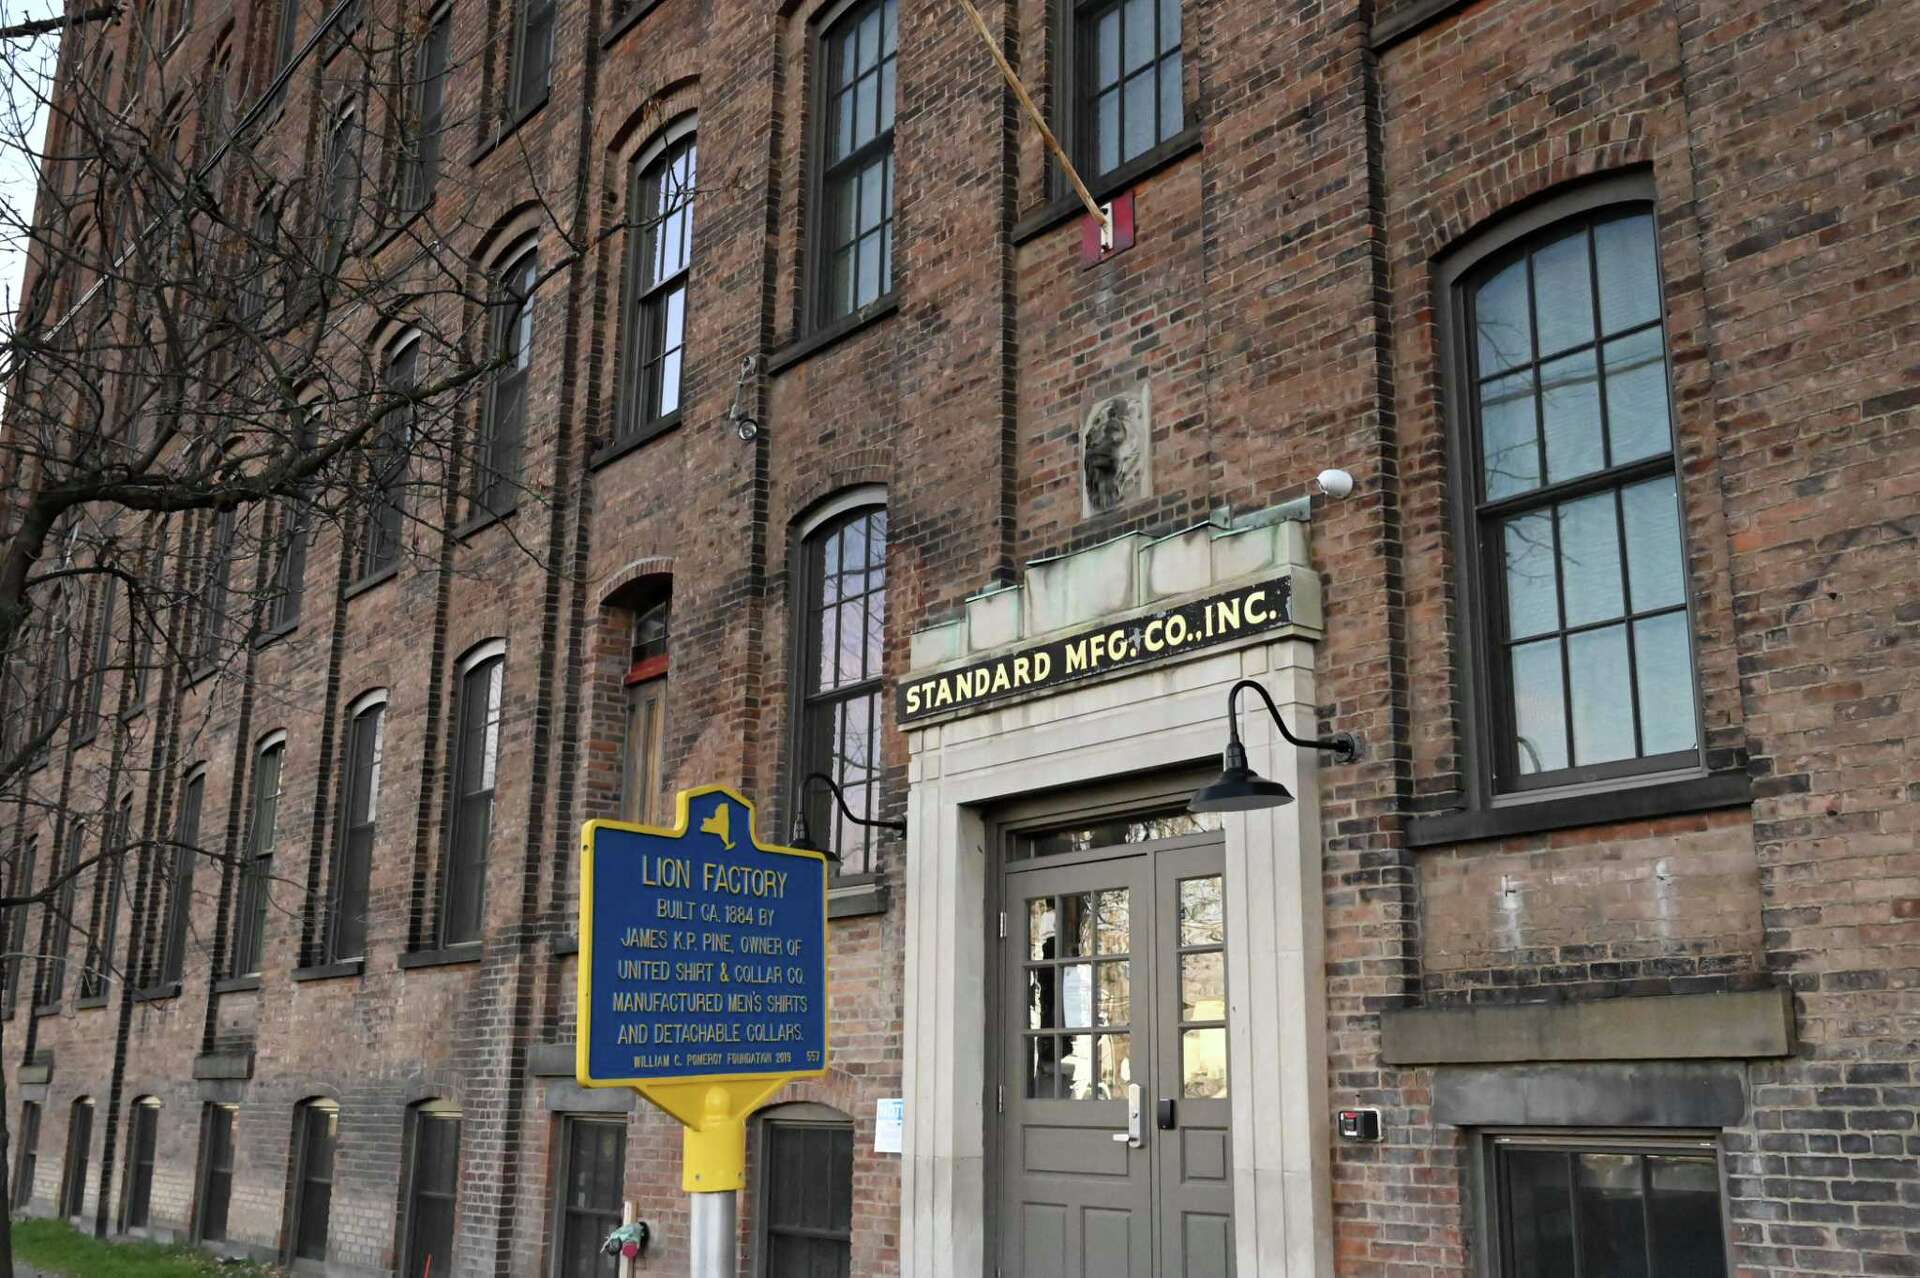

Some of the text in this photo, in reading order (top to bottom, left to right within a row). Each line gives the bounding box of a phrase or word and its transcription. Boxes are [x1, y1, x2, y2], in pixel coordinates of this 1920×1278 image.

[905, 651, 1051, 715] STANDARD
[1064, 629, 1137, 673] MFG.
[642, 854, 788, 898] LION FACTORY
[656, 898, 775, 926] BUILT CA. 1884 BY
[620, 928, 803, 956] JAMES K.P. PINE, OWNER OF
[617, 959, 670, 981] UNITED
[675, 962, 714, 983] SHIRT
[720, 962, 730, 982] &
[735, 964, 783, 984] COLLAR
[612, 991, 808, 1013] MANUFACTURED MEN'S SHIRTS
[617, 1023, 804, 1045] AND DETACHABLE COLLARS.
[633, 1054, 670, 1068] WILLIAM
[674, 1055, 683, 1067] C.
[686, 1052, 723, 1066] POMEROY
